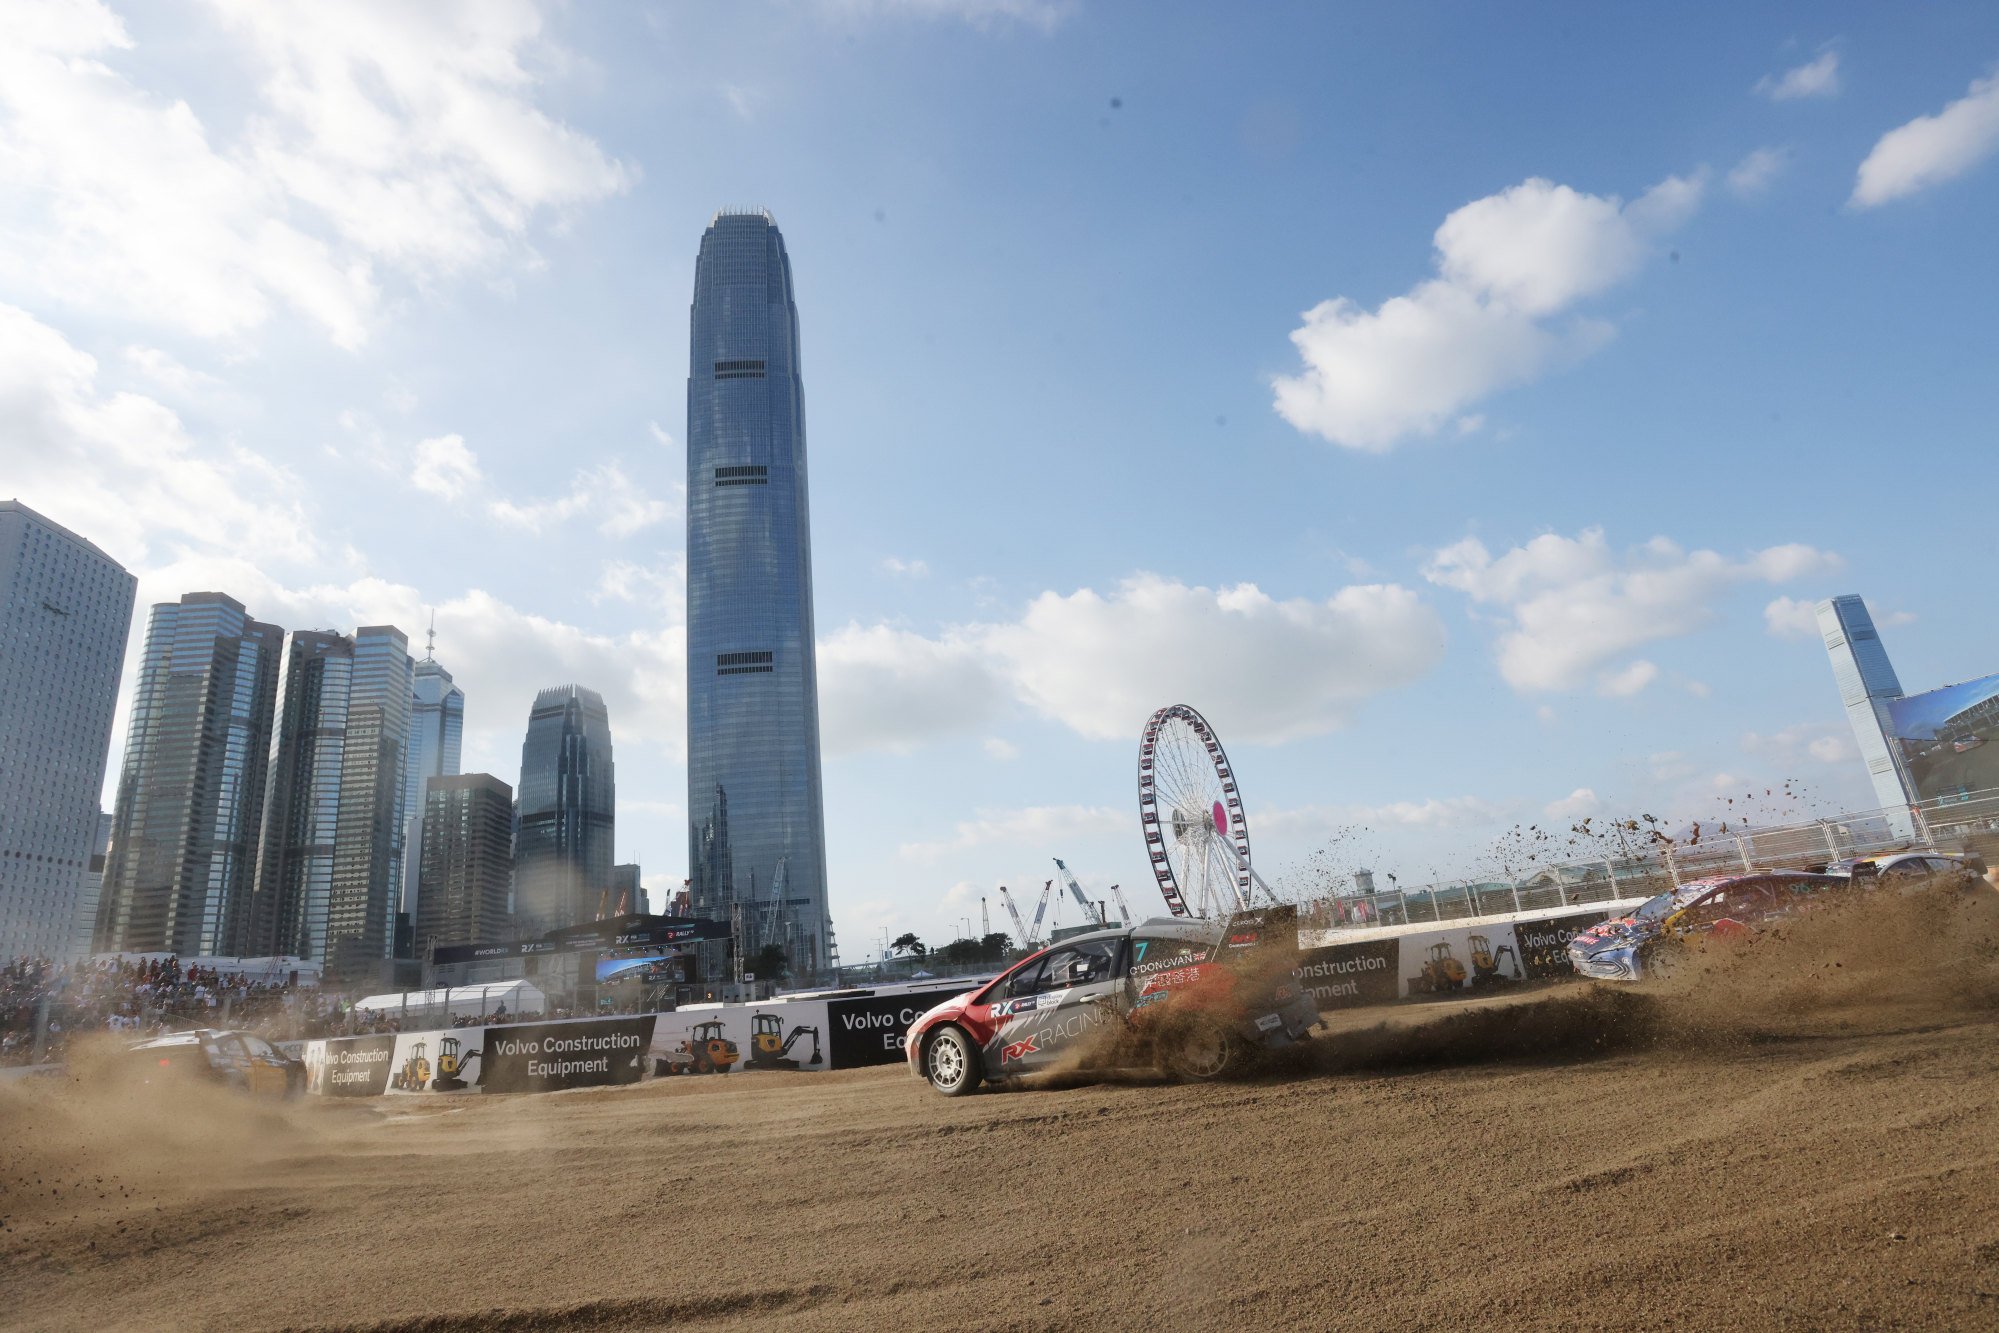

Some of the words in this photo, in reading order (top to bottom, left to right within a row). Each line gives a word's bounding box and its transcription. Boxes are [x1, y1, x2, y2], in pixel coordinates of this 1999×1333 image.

[1524, 932, 1557, 948] Volvo
[1135, 942, 1148, 962] 7
[1130, 953, 1193, 975] O'DONOVAN
[1297, 956, 1386, 978] onstruction
[842, 1011, 894, 1030] Volvo
[495, 1039, 539, 1056] Volvo
[544, 1032, 640, 1053] Construction
[1002, 1032, 1040, 1065] RX
[341, 1047, 389, 1064] Construction
[332, 1068, 371, 1086] Equipment
[527, 1056, 608, 1078] Equipment
